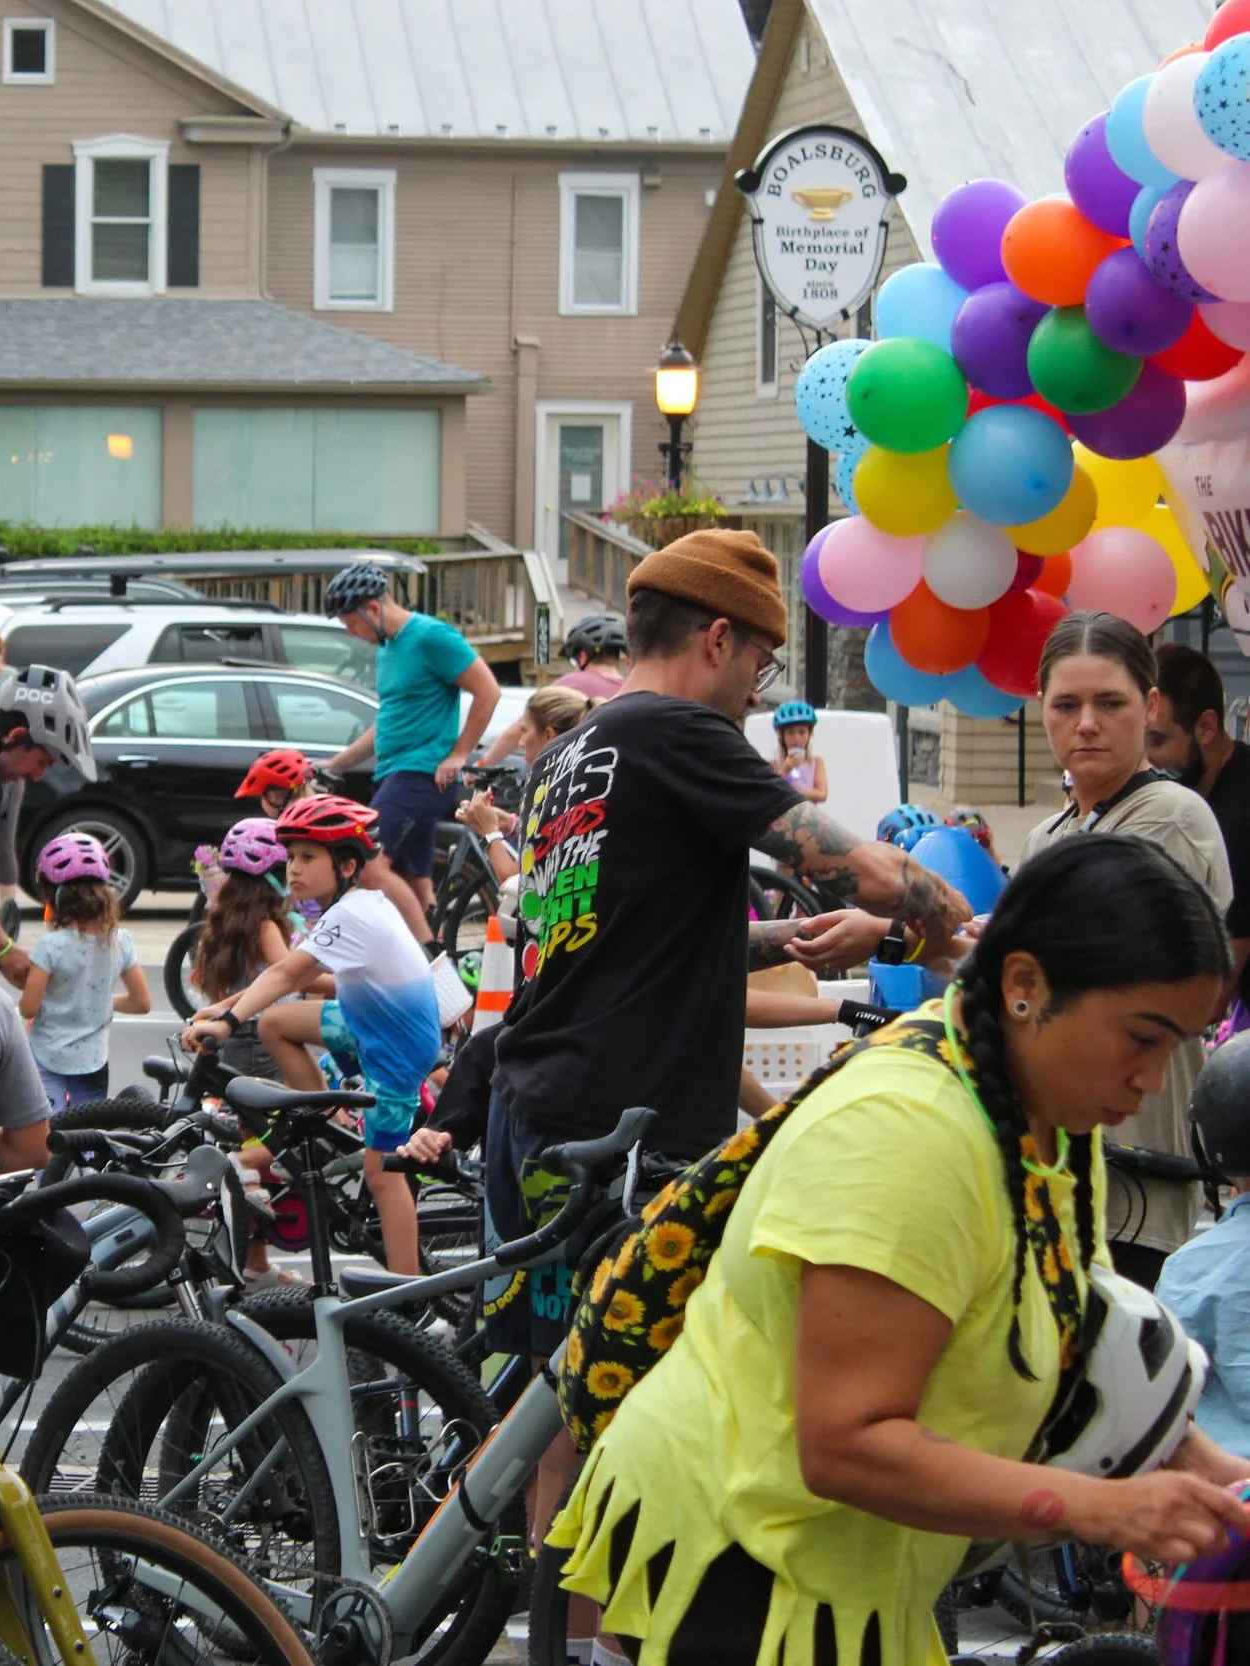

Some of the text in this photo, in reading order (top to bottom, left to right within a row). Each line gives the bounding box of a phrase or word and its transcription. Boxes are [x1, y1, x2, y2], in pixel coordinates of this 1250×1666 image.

[767, 144, 876, 198] BOALSBURG
[776, 226, 870, 240] Birthplace of
[779, 242, 865, 254] Memorial
[805, 259, 838, 274] Day
[802, 288, 838, 300] 1808
[1195, 475, 1213, 496] THE
[1203, 507, 1250, 577] BIK
[560, 828, 610, 871] THE
